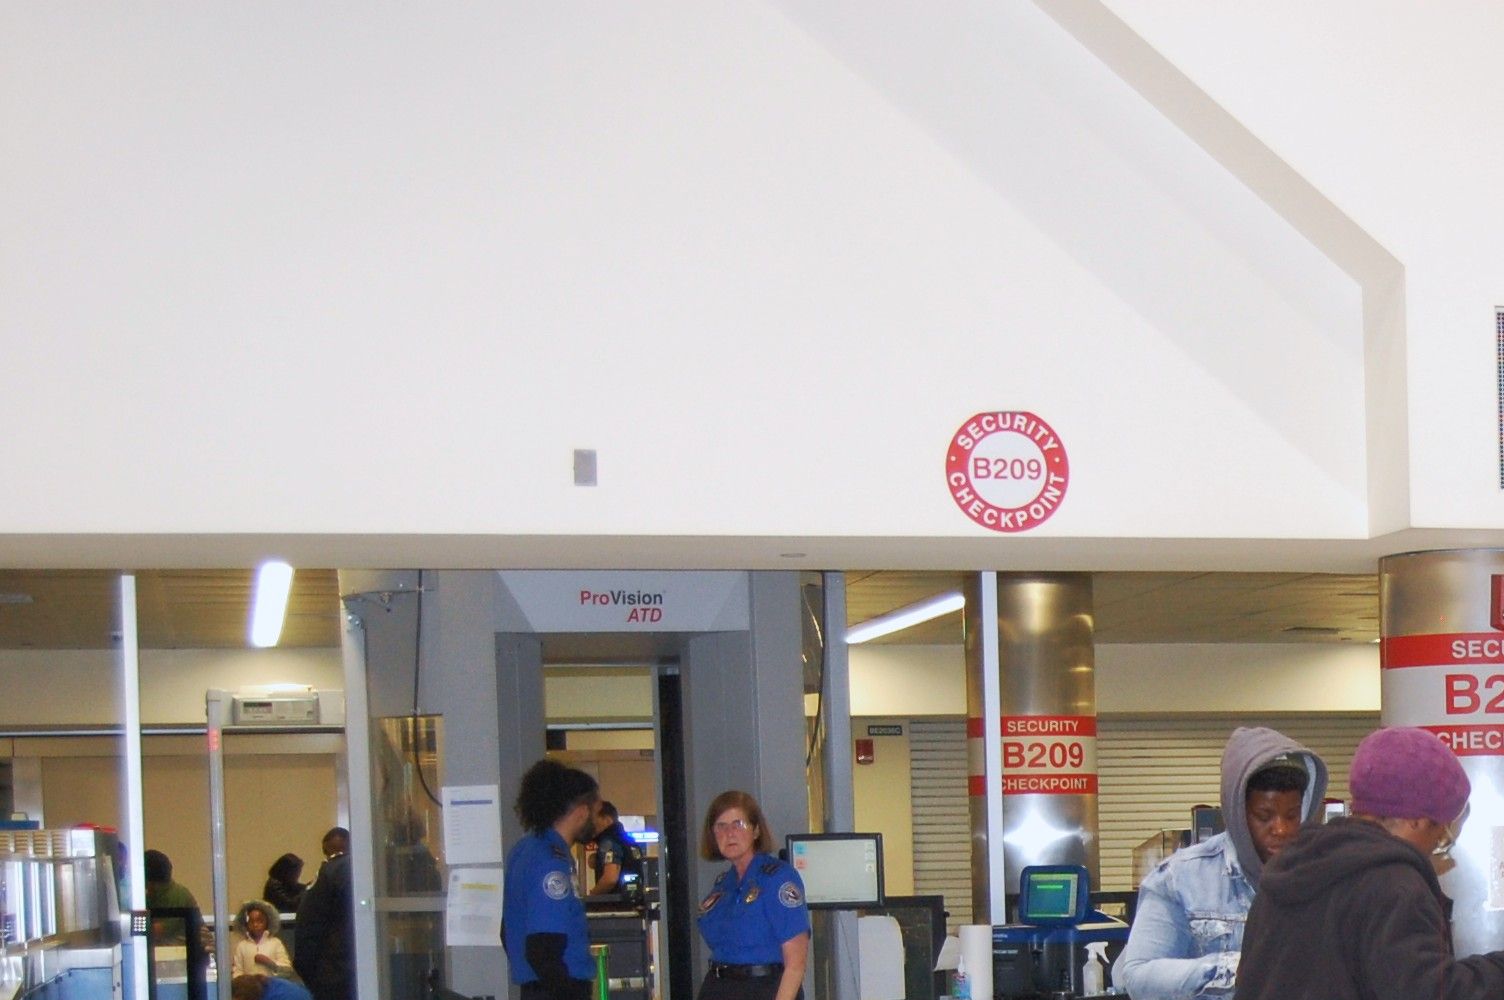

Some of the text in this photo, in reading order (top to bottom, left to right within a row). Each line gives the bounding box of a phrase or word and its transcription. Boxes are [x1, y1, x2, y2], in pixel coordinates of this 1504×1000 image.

[957, 413, 1058, 451] SECURITY
[973, 457, 1042, 480] B209
[950, 471, 1065, 529] CHECKPOINT
[580, 590, 663, 605] ProVision
[627, 607, 663, 622] ATD
[1007, 720, 1079, 732] SECURITY
[1003, 742, 1084, 768] B209
